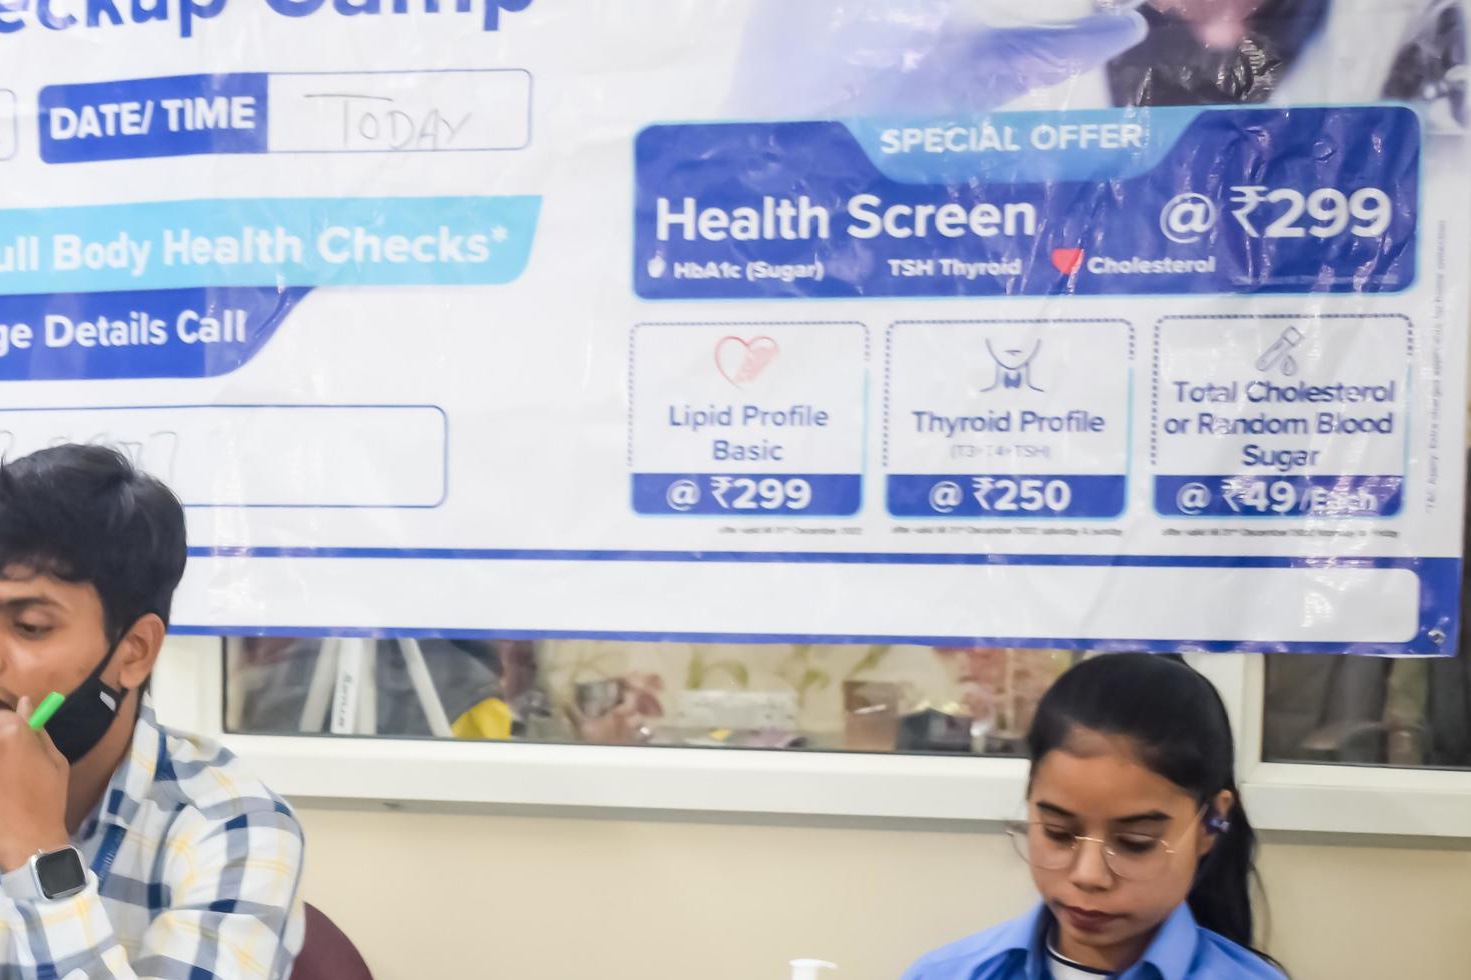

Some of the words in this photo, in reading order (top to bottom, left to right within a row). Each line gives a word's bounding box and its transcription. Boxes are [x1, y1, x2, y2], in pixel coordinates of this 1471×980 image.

[50, 101, 153, 140] DATE/
[163, 97, 256, 132] TIME
[304, 93, 473, 151] TODAY
[880, 122, 1021, 154] SPECIAL
[1031, 122, 1143, 151] OFFER
[656, 195, 829, 241] Health
[846, 193, 1036, 239] Screen
[1231, 185, 1392, 240] ₹299
[53, 234, 151, 277] Body
[163, 227, 301, 267] Health
[1087, 256, 1216, 275] Cholesterol
[745, 259, 825, 282] (Sugar)
[888, 259, 932, 276] TSH
[938, 257, 1022, 280] Thyroid
[45, 312, 168, 349] Details
[176, 308, 246, 344] Call
[1172, 380, 1237, 403] Total
[1246, 380, 1396, 403] Cholesterol
[668, 405, 732, 431] Lipid
[741, 404, 829, 428] Profile
[911, 410, 1011, 438] Thyroid
[1020, 409, 1105, 433] Profile
[1164, 417, 1191, 435] or
[1197, 412, 1308, 435] Random
[1316, 411, 1393, 435] Blood
[712, 439, 784, 462] Basic
[1241, 444, 1321, 472] Sugar
[710, 476, 812, 510] ₹299
[971, 477, 1072, 512] ₹250
